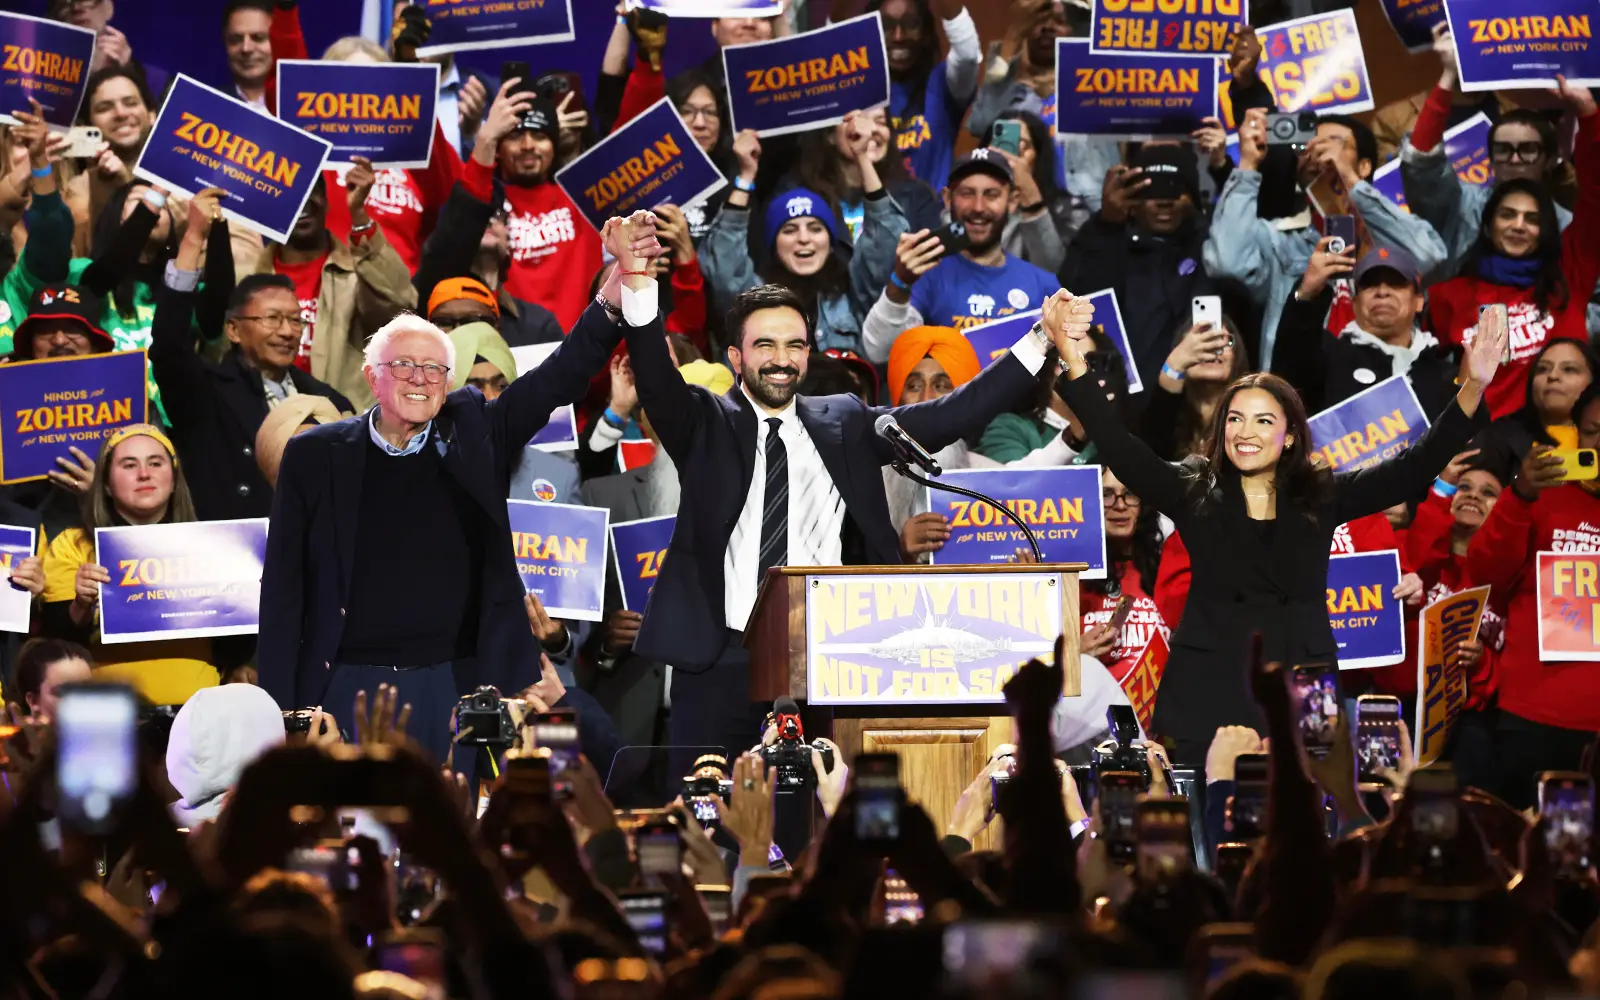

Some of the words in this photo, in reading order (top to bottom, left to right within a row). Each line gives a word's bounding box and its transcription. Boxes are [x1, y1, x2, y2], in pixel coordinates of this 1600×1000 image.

[452, 6, 480, 16] NEW
[483, 2, 514, 13] YORK
[1099, 17, 1158, 48] FREE
[1468, 14, 1592, 43] ZOHRAN
[1497, 43, 1525, 54] NEW
[1528, 42, 1559, 53] YORK
[1562, 41, 1588, 52] CITY
[2, 44, 83, 84] ZOHRAN
[745, 45, 870, 94] ZOHRAN
[773, 89, 801, 102] NEW
[804, 82, 836, 97] YORK
[838, 74, 865, 89] CITY
[1075, 67, 1199, 94] ZOHRAN
[296, 91, 421, 120] ZOHRAN
[1098, 97, 1127, 108] NEW
[1129, 97, 1162, 108] YORK
[1164, 97, 1193, 108] CITY
[320, 121, 350, 133] NEW
[353, 123, 385, 134] YORK
[387, 125, 413, 135] CITY
[172, 111, 302, 188] ZOHRAN
[191, 151, 222, 171] NEW
[222, 163, 254, 186] YORK
[255, 179, 283, 198] CITY
[584, 132, 681, 211] ZOHRAN
[43, 389, 88, 402] HINDUS
[16, 397, 132, 434] ZOHRAN
[39, 433, 67, 444] NEW
[69, 431, 100, 441] YORK
[1321, 407, 1410, 471] HRAN
[1382, 438, 1410, 460] CITY
[512, 531, 588, 564] RAN
[976, 531, 1007, 542] NEW
[1048, 529, 1079, 540] CITY
[548, 566, 579, 578] CITY
[1552, 560, 1600, 598] FR
[147, 590, 177, 600] NEW
[1326, 583, 1384, 614] RAN
[816, 582, 921, 645] NEW
[921, 580, 1053, 643] YORK
[1348, 616, 1378, 628] CITY
[919, 648, 955, 668] IS
[816, 654, 883, 697] NOT
[892, 670, 960, 697] FOR
[1423, 664, 1445, 755] ALL
